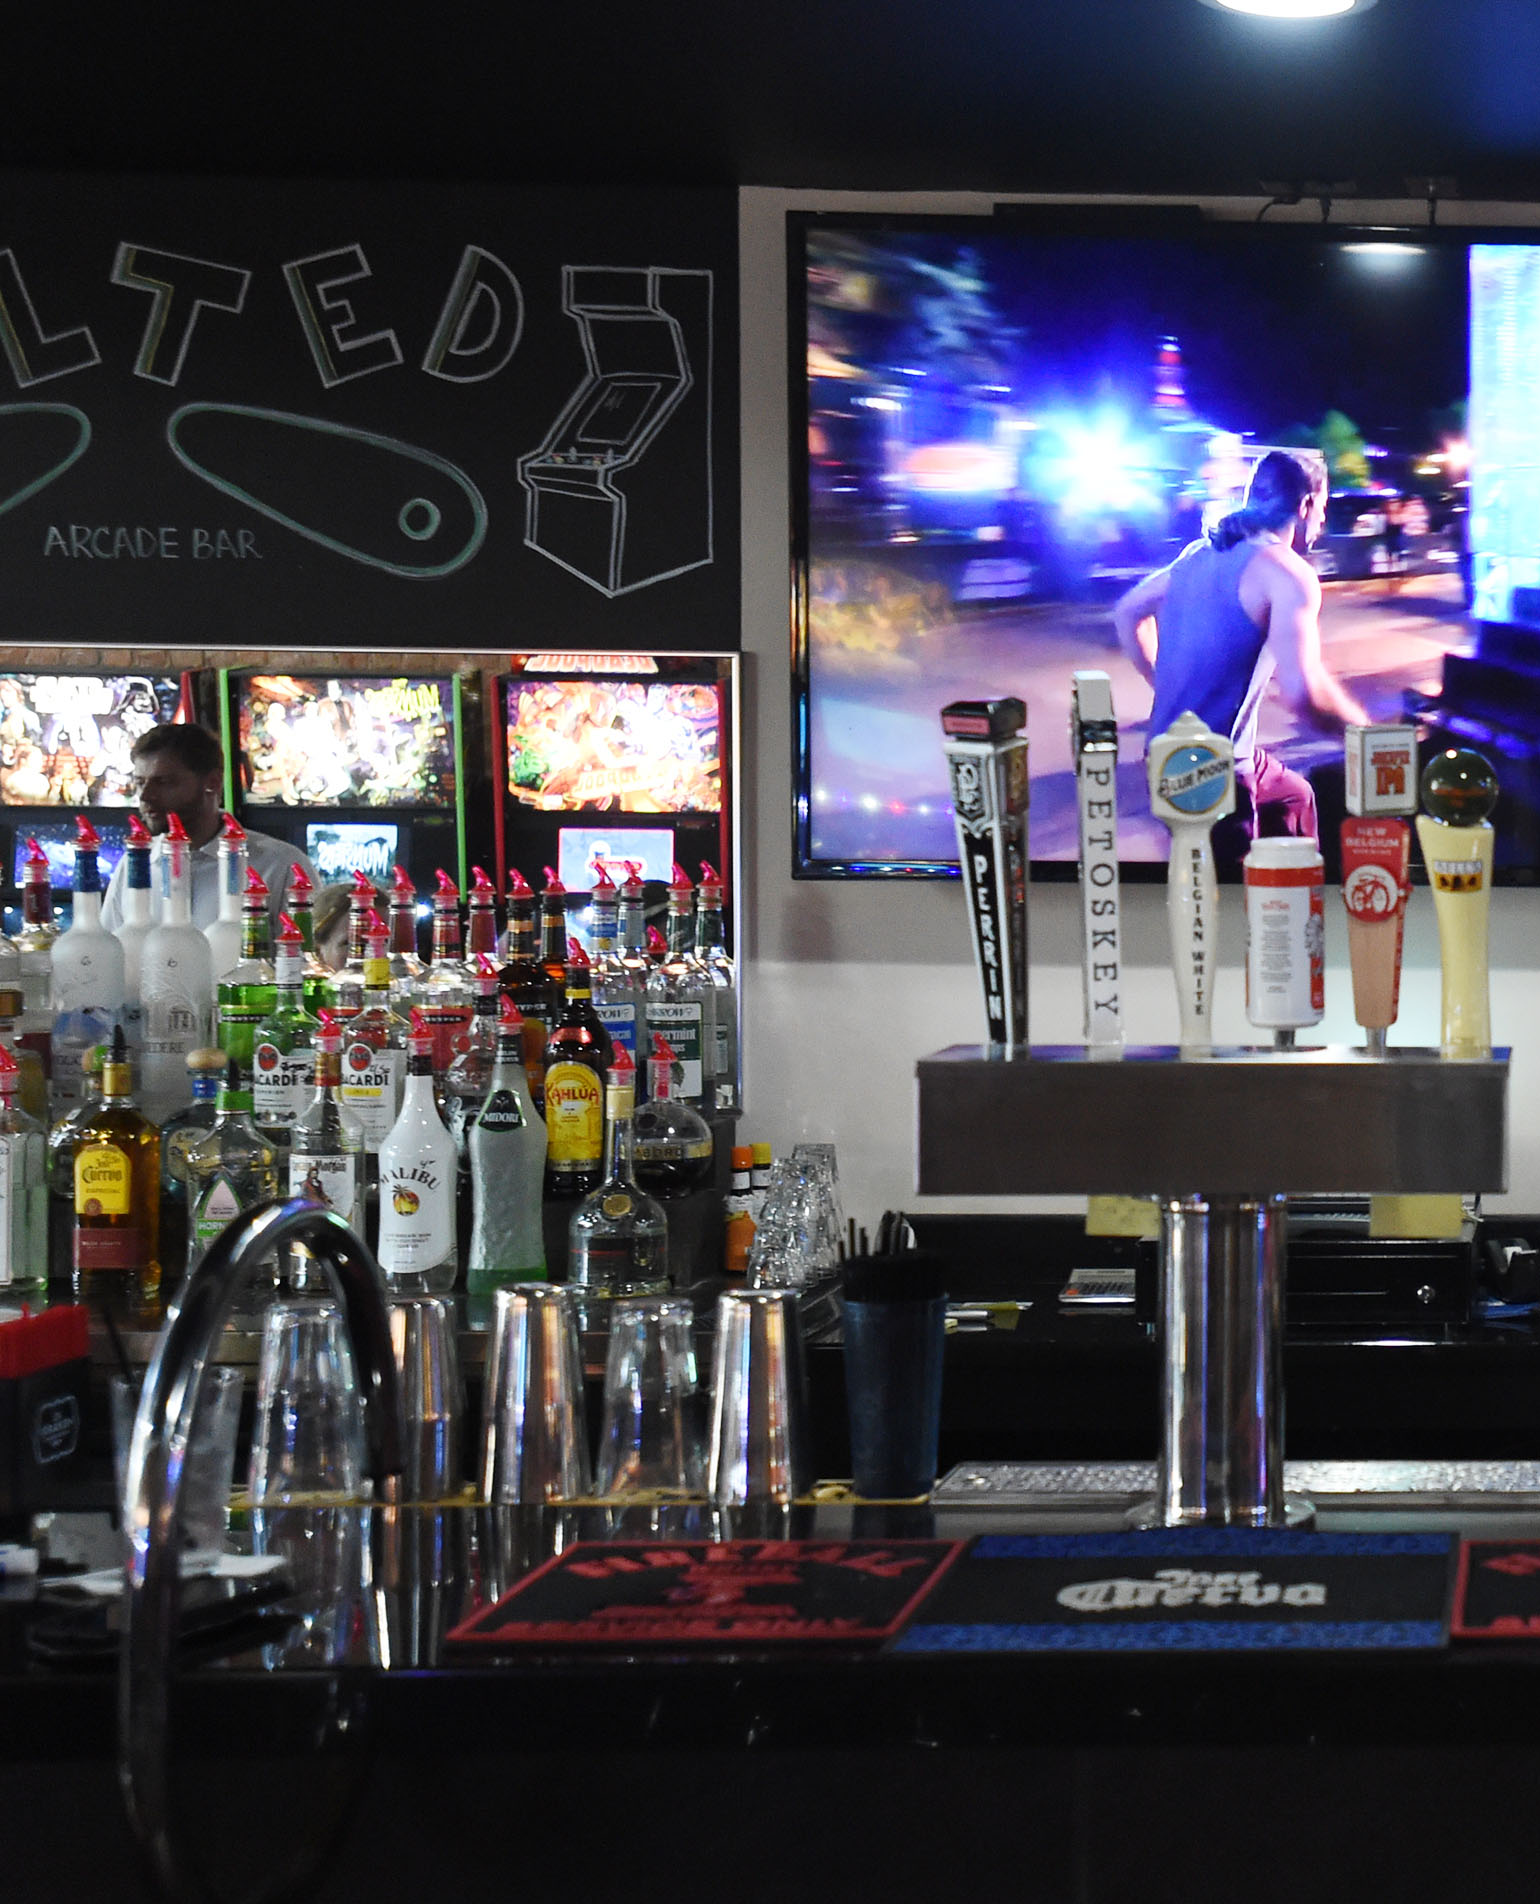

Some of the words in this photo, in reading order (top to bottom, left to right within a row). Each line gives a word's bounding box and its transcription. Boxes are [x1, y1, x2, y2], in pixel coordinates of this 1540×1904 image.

[43, 526, 179, 560] ARCADE
[191, 527, 263, 560] BAR
[1197, 760, 1231, 783] MOON
[1345, 837, 1399, 848] BELGIUM
[1357, 827, 1387, 837] NEW
[1086, 767, 1118, 1016] PETOSKEY
[1191, 848, 1204, 942] BELGIAN
[973, 854, 1004, 1021] PERRIN
[1191, 951, 1205, 1015] WHITE
[545, 1082, 600, 1106] KAHLÚA
[482, 1111, 519, 1124] MIDORI
[380, 1167, 442, 1191] MALIBU
